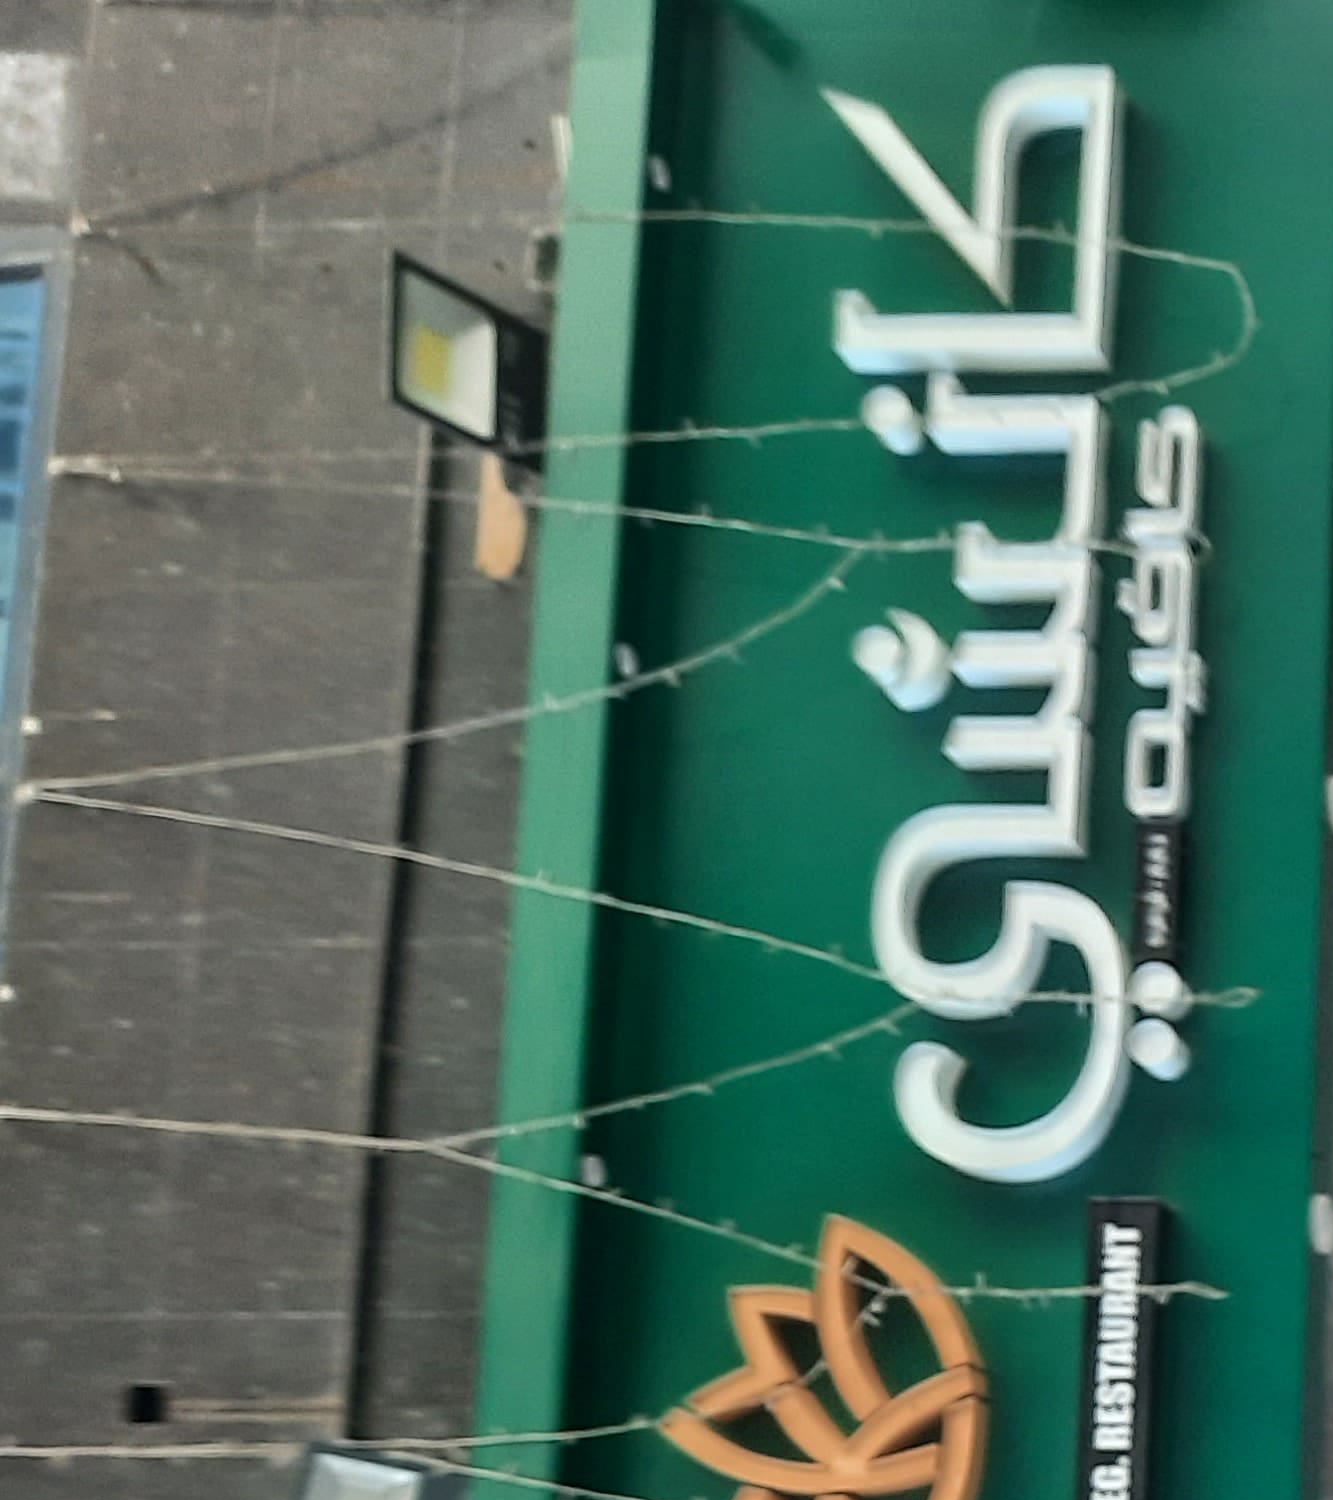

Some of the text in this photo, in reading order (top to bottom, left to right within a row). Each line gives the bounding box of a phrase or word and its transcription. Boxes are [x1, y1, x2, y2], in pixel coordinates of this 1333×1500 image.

[819, 64, 1191, 1183] كانشي
[1116, 404, 1207, 817] كافيه
[1093, 1222, 1143, 1451] RESTAURANT
